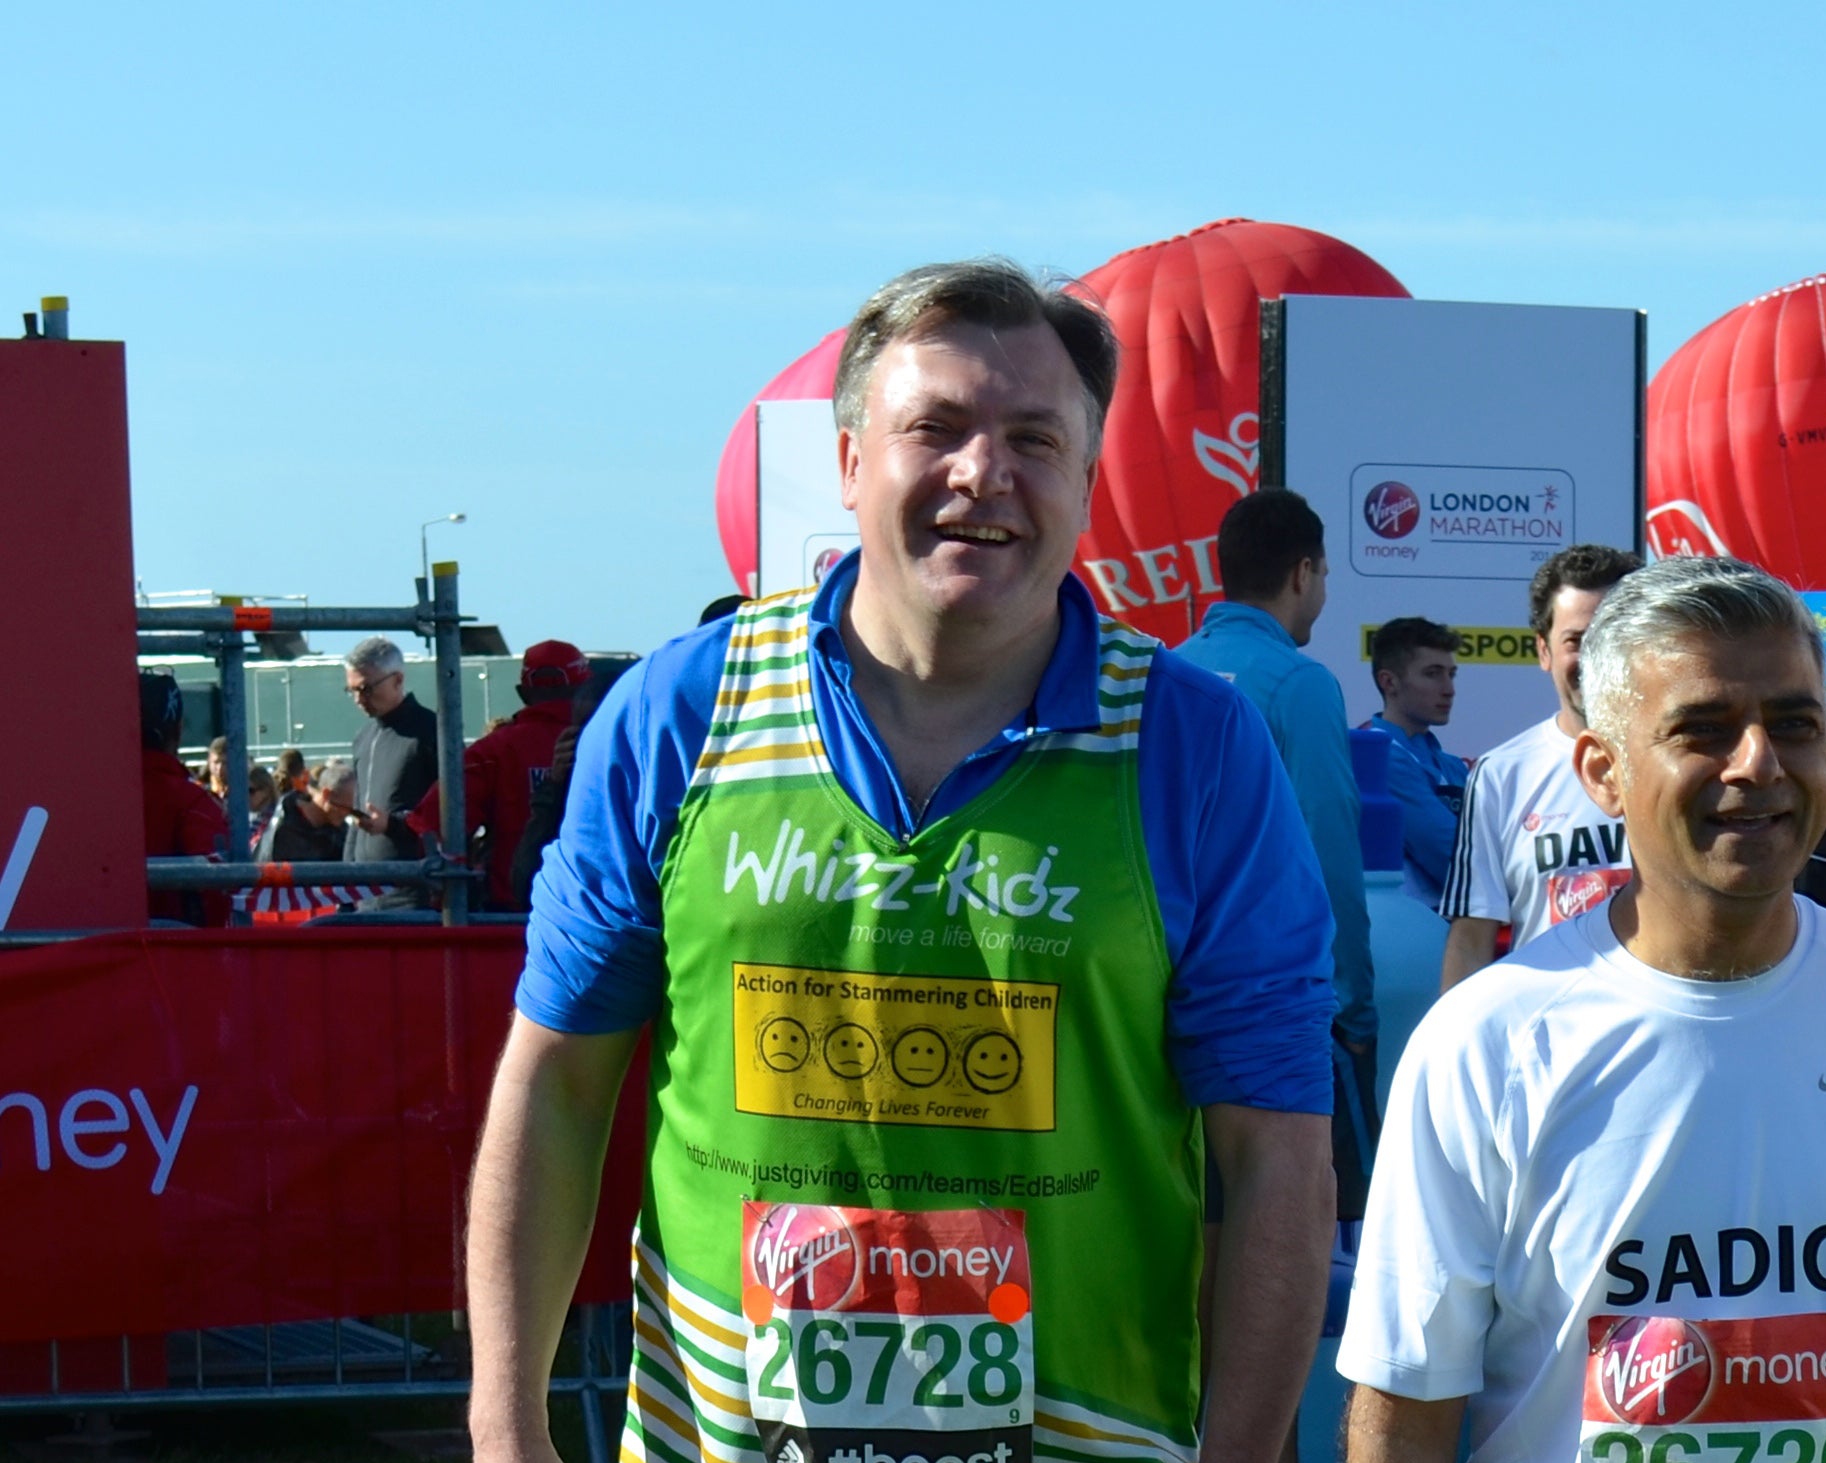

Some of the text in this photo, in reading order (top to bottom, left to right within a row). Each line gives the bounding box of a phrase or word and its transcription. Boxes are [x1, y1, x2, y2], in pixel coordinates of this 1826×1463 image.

[1367, 487, 1417, 532] Virgin
[1430, 493, 1531, 513] LONDON
[1430, 516, 1563, 538] MARATHON
[1364, 544, 1420, 562] money
[850, 923, 1073, 958] move a life forward
[736, 973, 1053, 1010] Action for Stammering Children
[793, 1092, 991, 1120] Changing Lives Forever
[686, 1141, 1100, 1198] http://www.justgiving.com/teams/EdBallsMP
[757, 1206, 1015, 1301] Virgin money
[754, 1316, 1023, 1409] 26728
[1605, 1320, 1706, 1416] Virgin
[1008, 1408, 1020, 1424] 9
